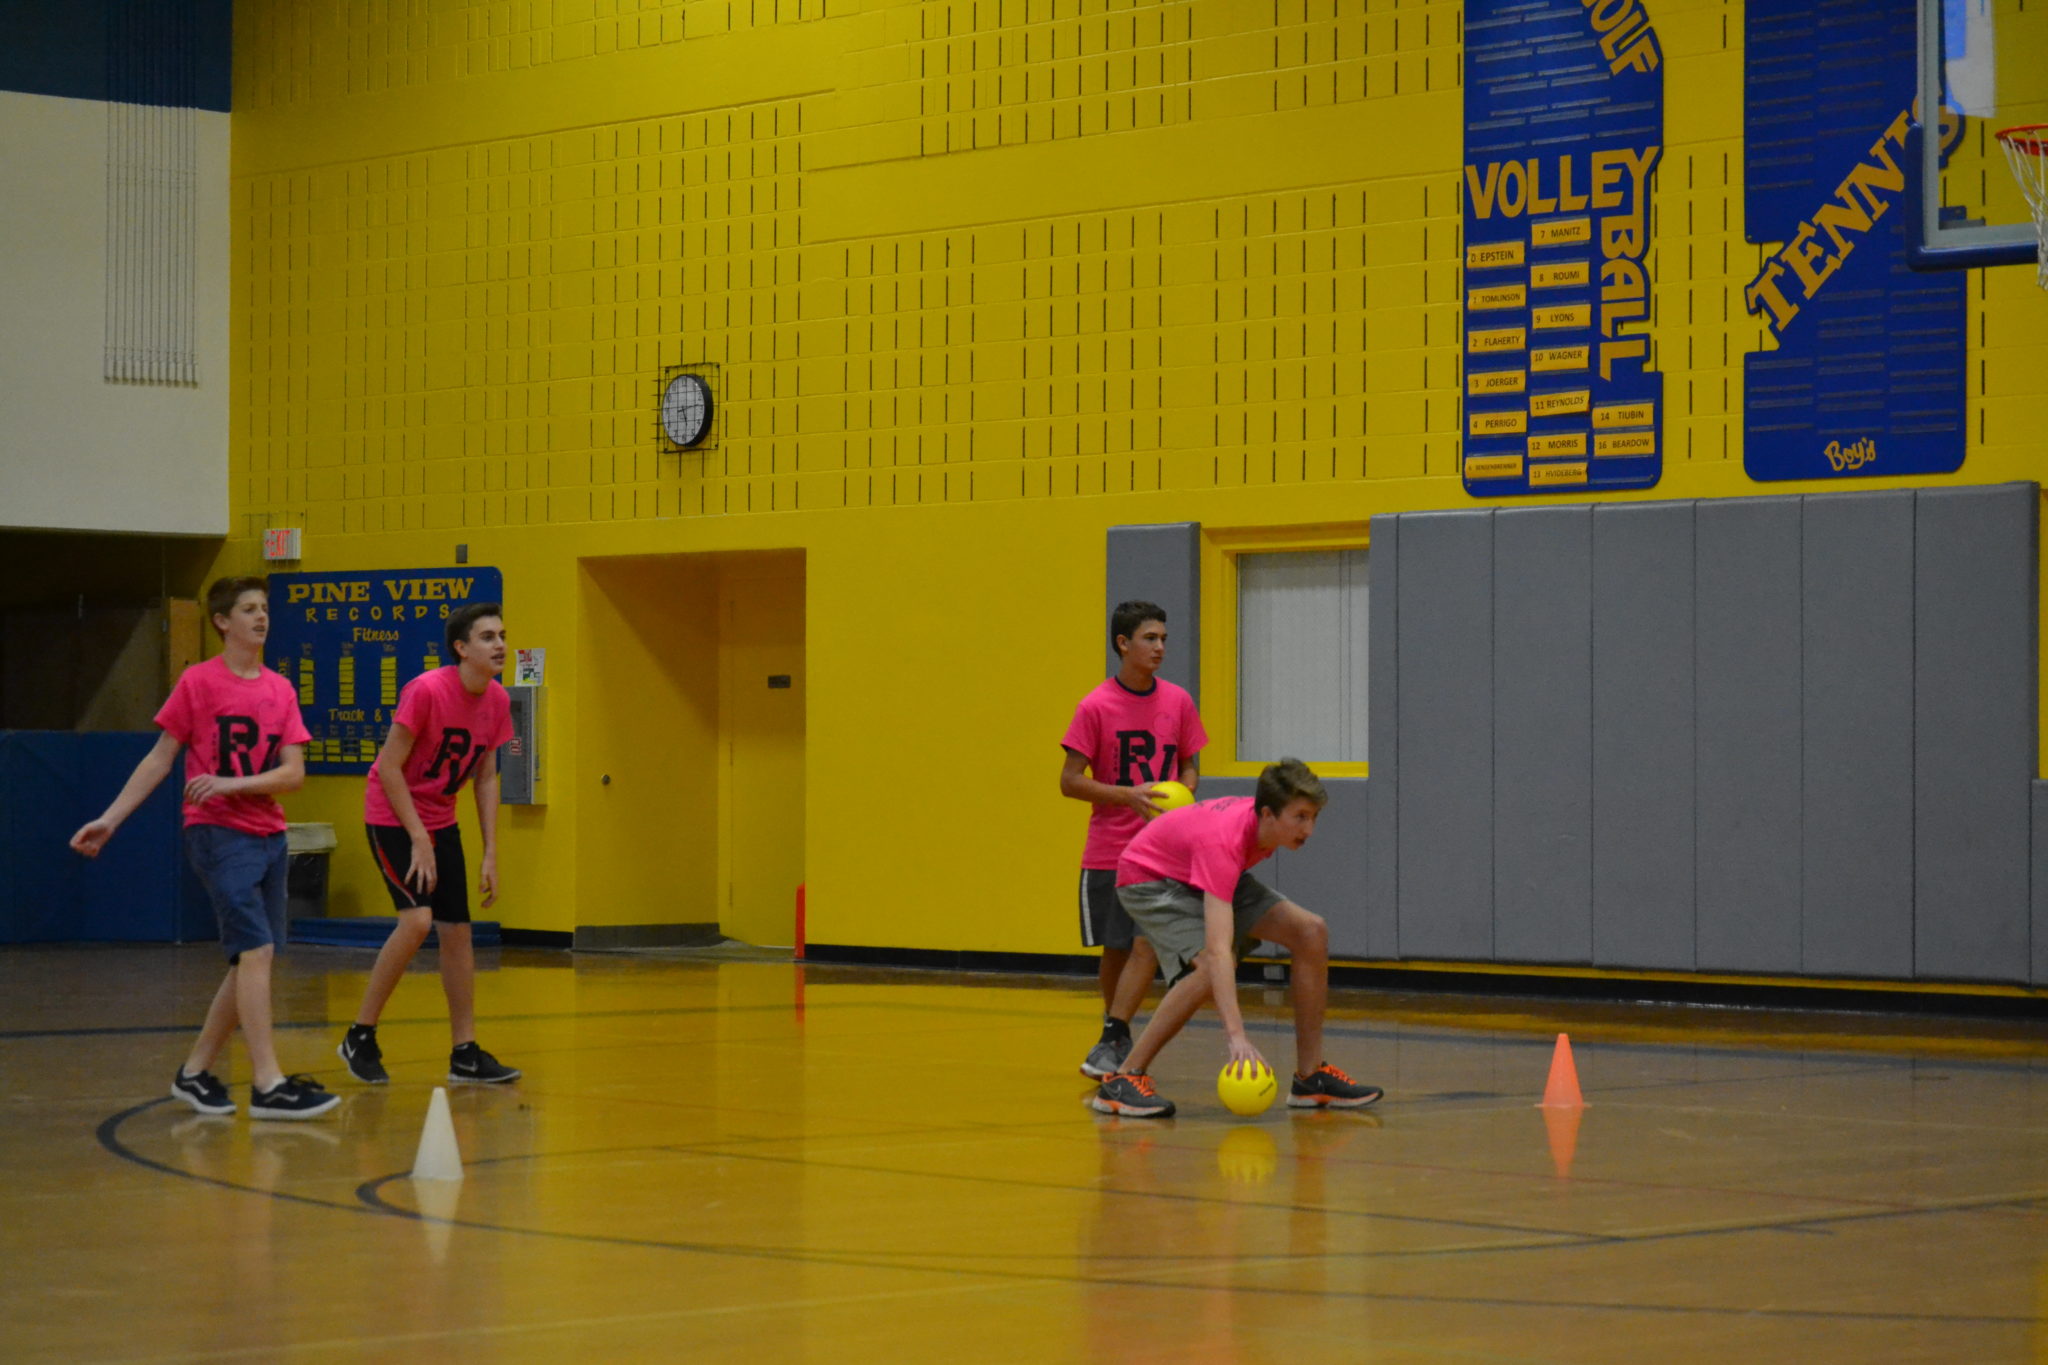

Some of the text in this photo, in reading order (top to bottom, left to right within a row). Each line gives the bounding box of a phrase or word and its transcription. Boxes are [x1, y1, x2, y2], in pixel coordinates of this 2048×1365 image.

[1581, 0, 1659, 76] OLF
[1551, 227, 1581, 238] MANITZ
[1480, 251, 1514, 262] EPSTEIN
[1553, 271, 1580, 281] ROUMI
[1481, 293, 1521, 304] TOMLINSON
[1550, 312, 1575, 323] LYONS
[1484, 336, 1520, 347] FLAHERTY
[1535, 351, 1583, 362] 10 WAGNER
[1486, 377, 1518, 388] JOERGER
[1535, 396, 1585, 410] 11 REYNOLDS
[1600, 412, 1610, 421] 14
[1485, 419, 1517, 429] PERRIGO
[1532, 439, 1578, 450] 12 MORRIS
[1598, 438, 1650, 450] 16 BEARDOW
[1824, 437, 1876, 471] Boy's
[287, 577, 474, 604] PINE VIEW
[353, 627, 399, 642] Fitness
[328, 708, 364, 721] Track
[374, 708, 382, 723] &
